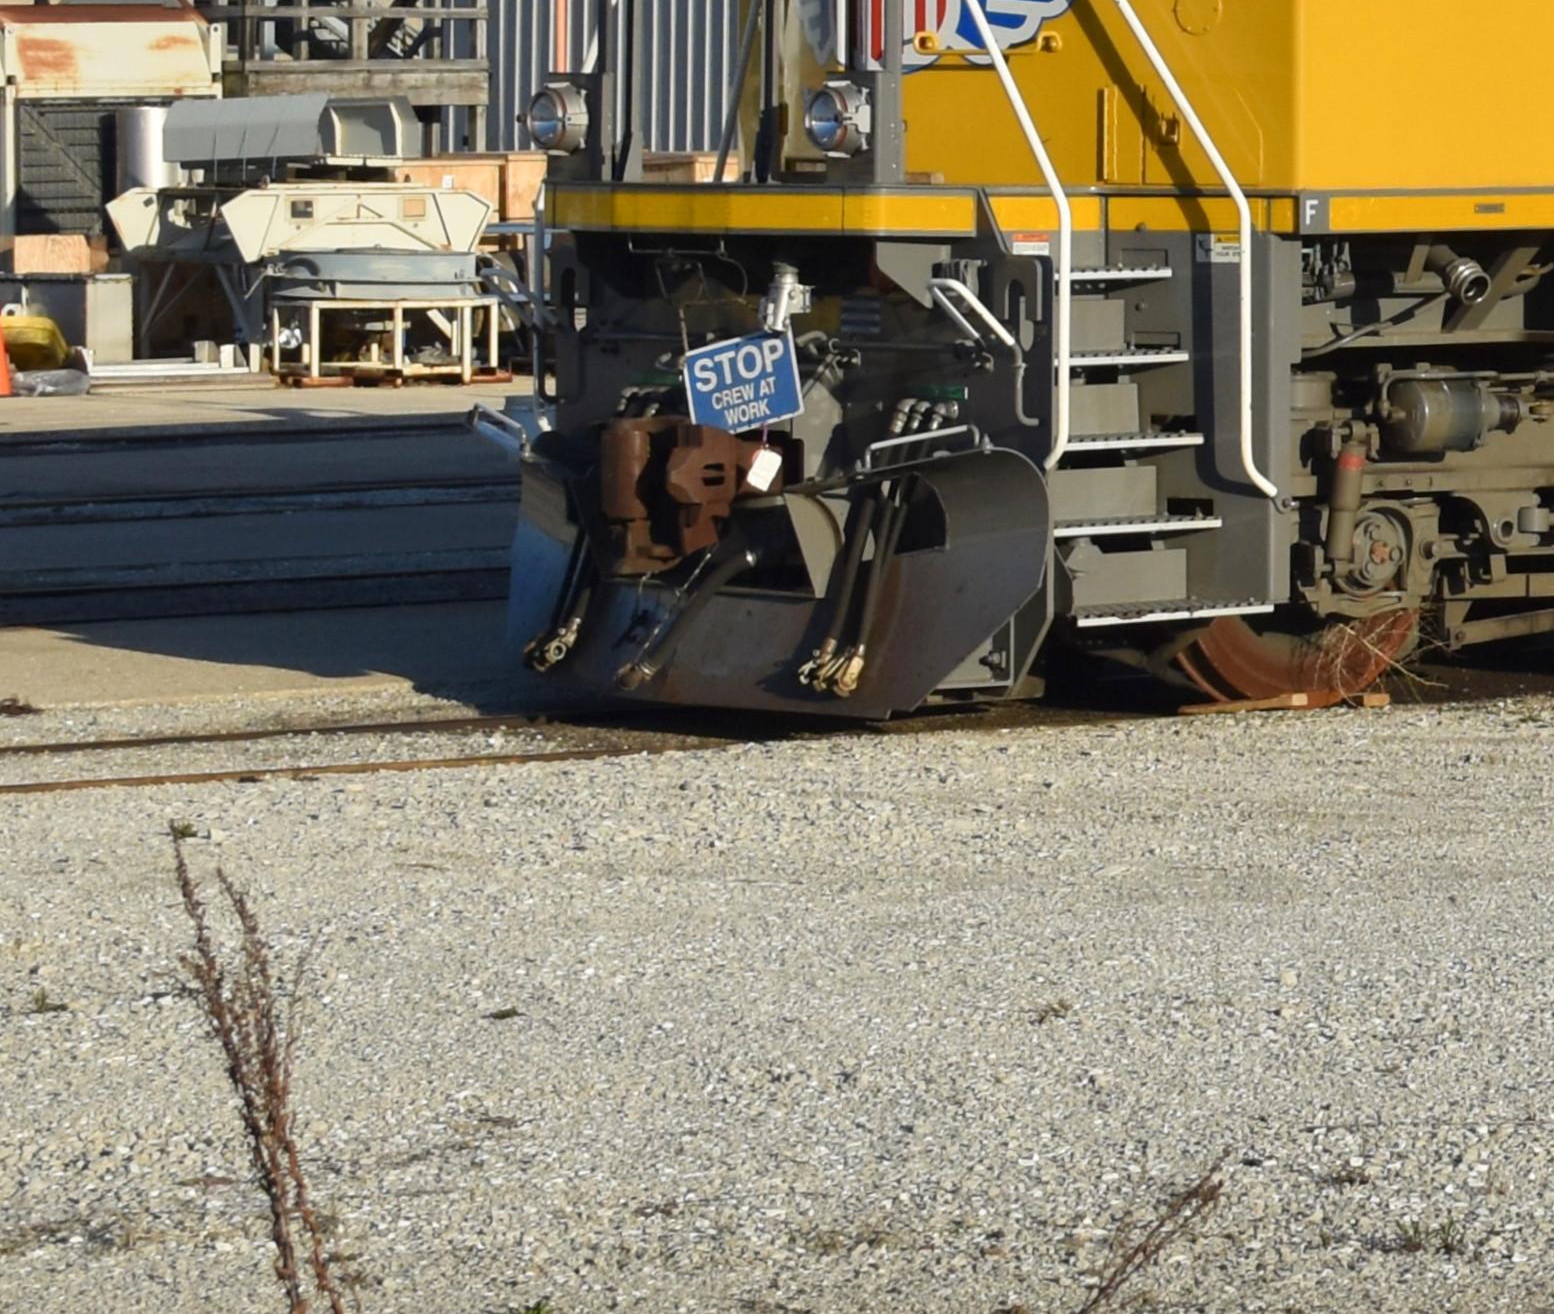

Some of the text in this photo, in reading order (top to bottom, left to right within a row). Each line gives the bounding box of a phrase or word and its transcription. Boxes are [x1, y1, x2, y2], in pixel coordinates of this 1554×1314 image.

[1305, 199, 1319, 225] F
[693, 338, 784, 392] STOP
[711, 376, 776, 410] CREW AT
[724, 398, 771, 425] WORK
